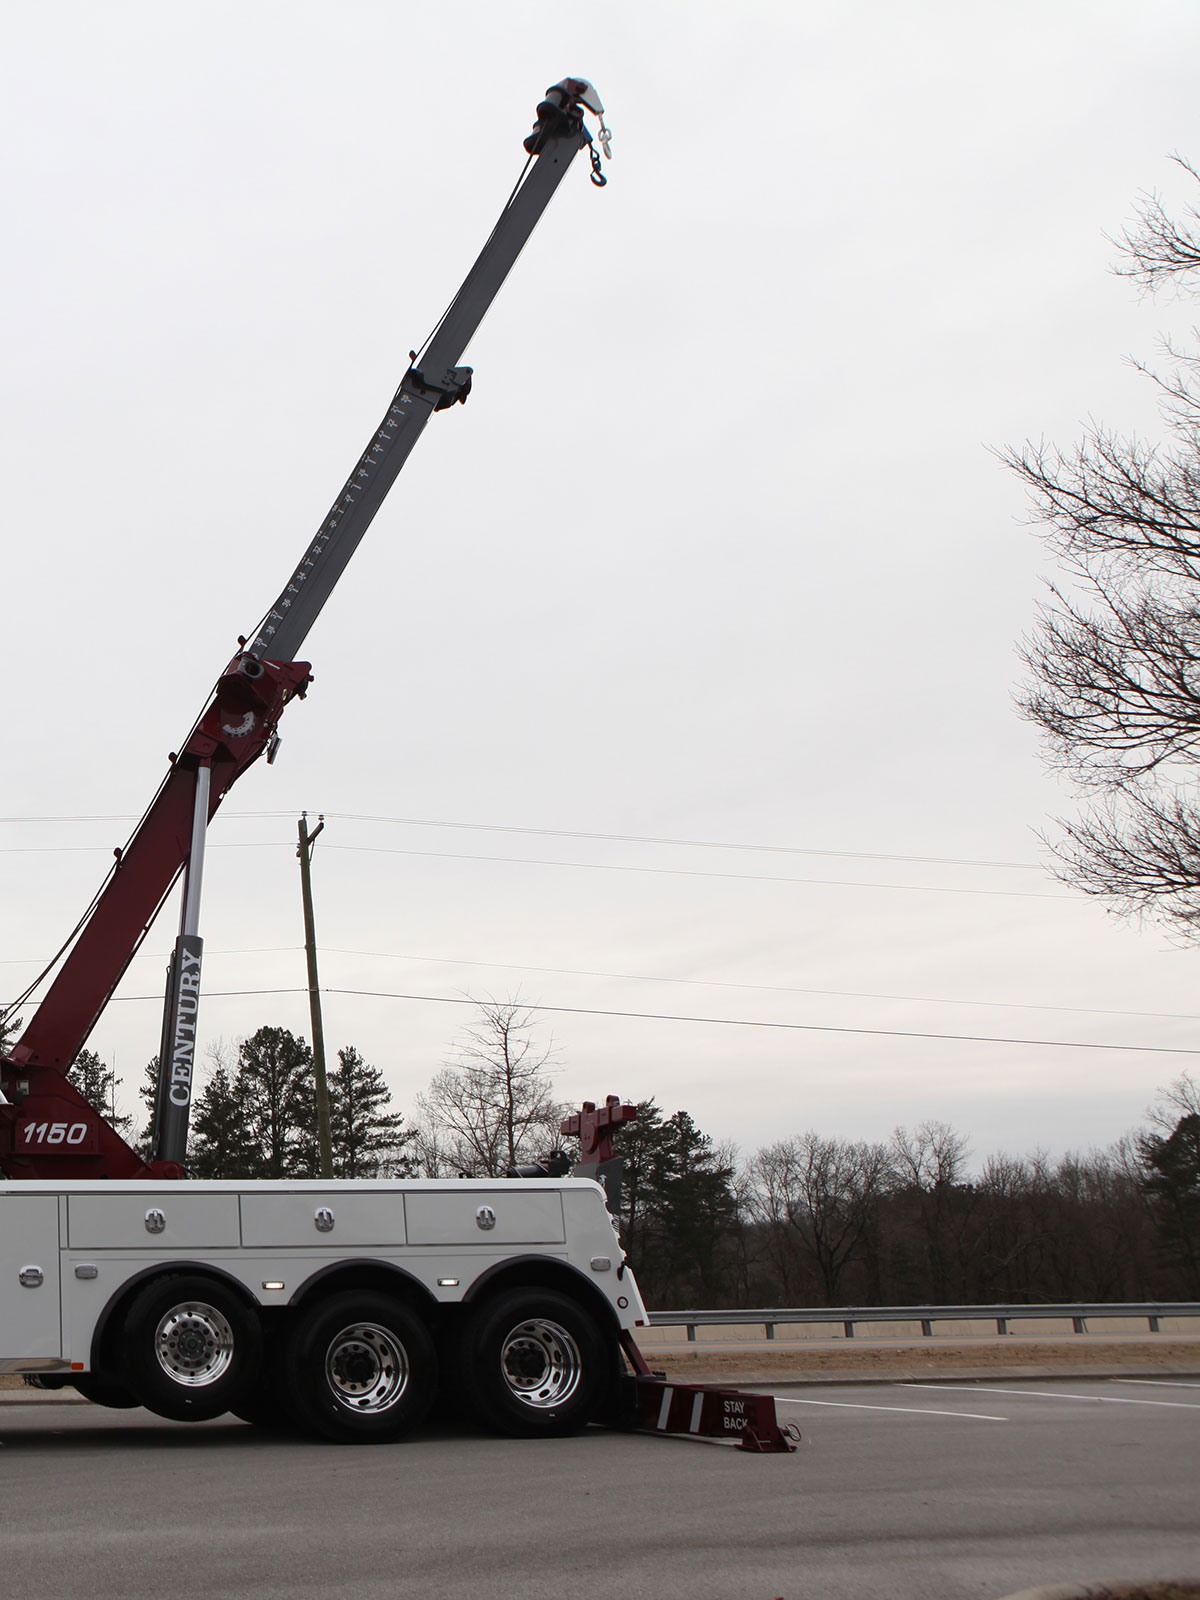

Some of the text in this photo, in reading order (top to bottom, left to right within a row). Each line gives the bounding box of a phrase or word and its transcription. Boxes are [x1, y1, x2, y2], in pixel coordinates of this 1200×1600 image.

[169, 948, 201, 1107] CENTURY
[24, 1122, 88, 1144] 1150
[724, 1400, 744, 1414] STAY
[724, 1416, 748, 1430] BACK
